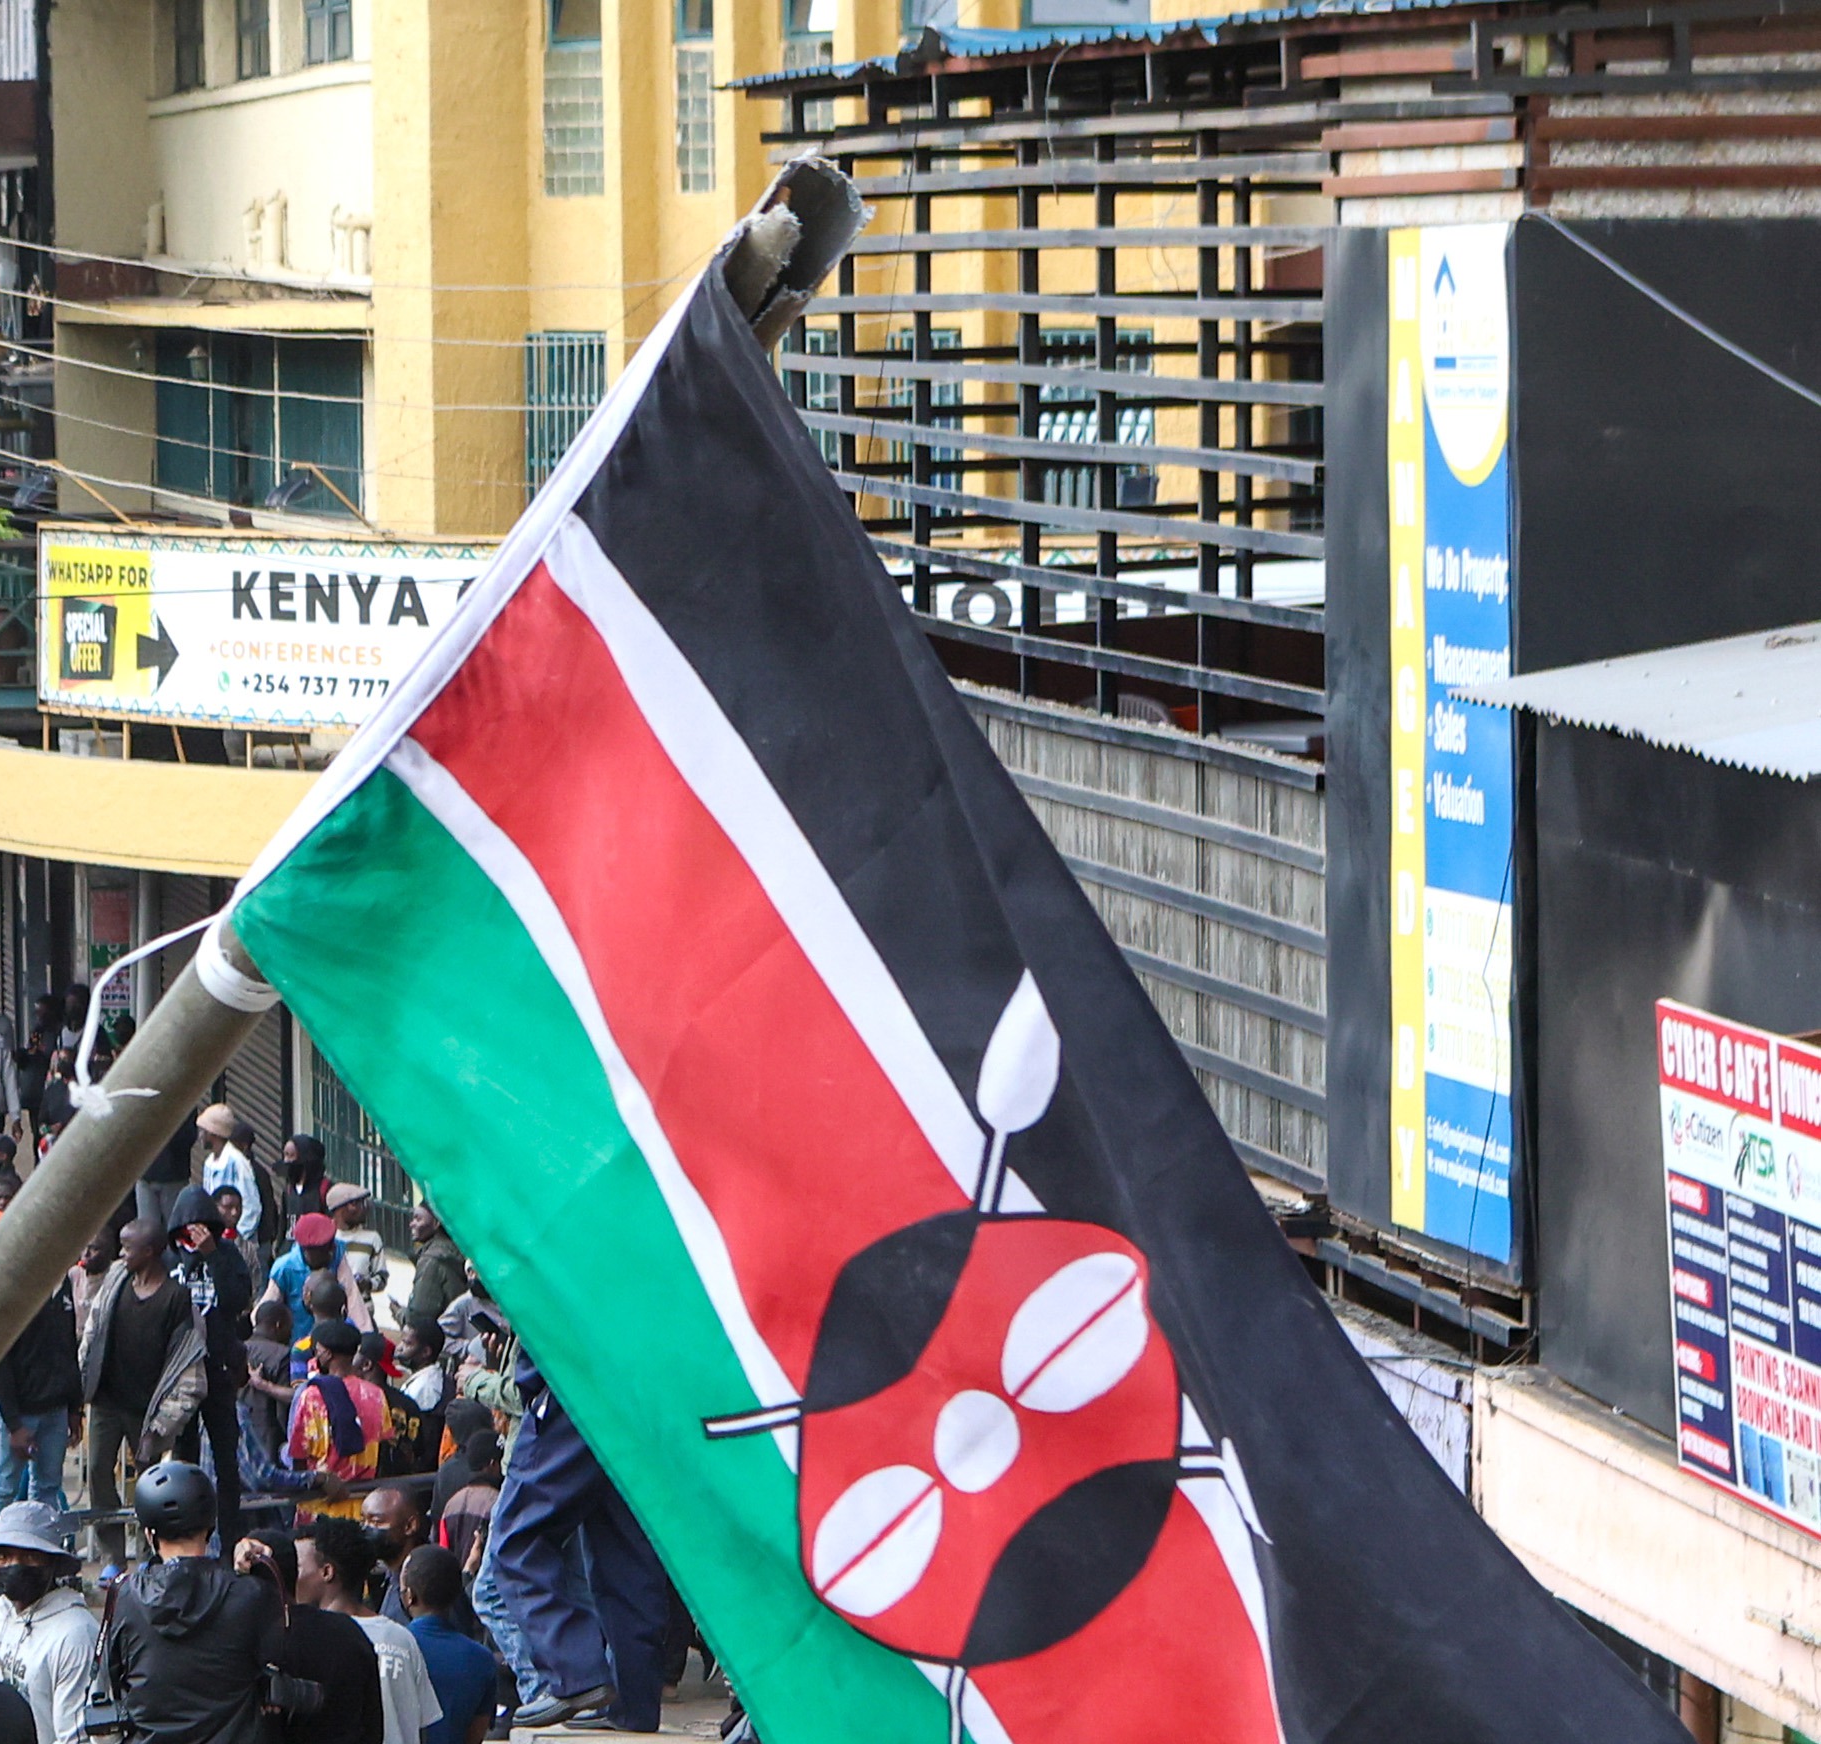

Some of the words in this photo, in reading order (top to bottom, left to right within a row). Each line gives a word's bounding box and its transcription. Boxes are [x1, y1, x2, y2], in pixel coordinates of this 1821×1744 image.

[47, 559, 114, 586] WHATSAPP
[118, 563, 148, 589] FOR
[1426, 546, 1443, 589] We
[1445, 548, 1459, 592] Do
[231, 570, 431, 627] KENYA
[65, 611, 108, 642] SPECIAL
[69, 642, 102, 672] OFFER
[241, 673, 289, 695] +254
[299, 676, 337, 697] 737
[349, 679, 390, 698] 777
[1433, 701, 1467, 755] Sales
[1662, 1015, 1718, 1091] CYBER
[1737, 1384, 1790, 1441] BROWSING
[1793, 1407, 1813, 1451] AND
